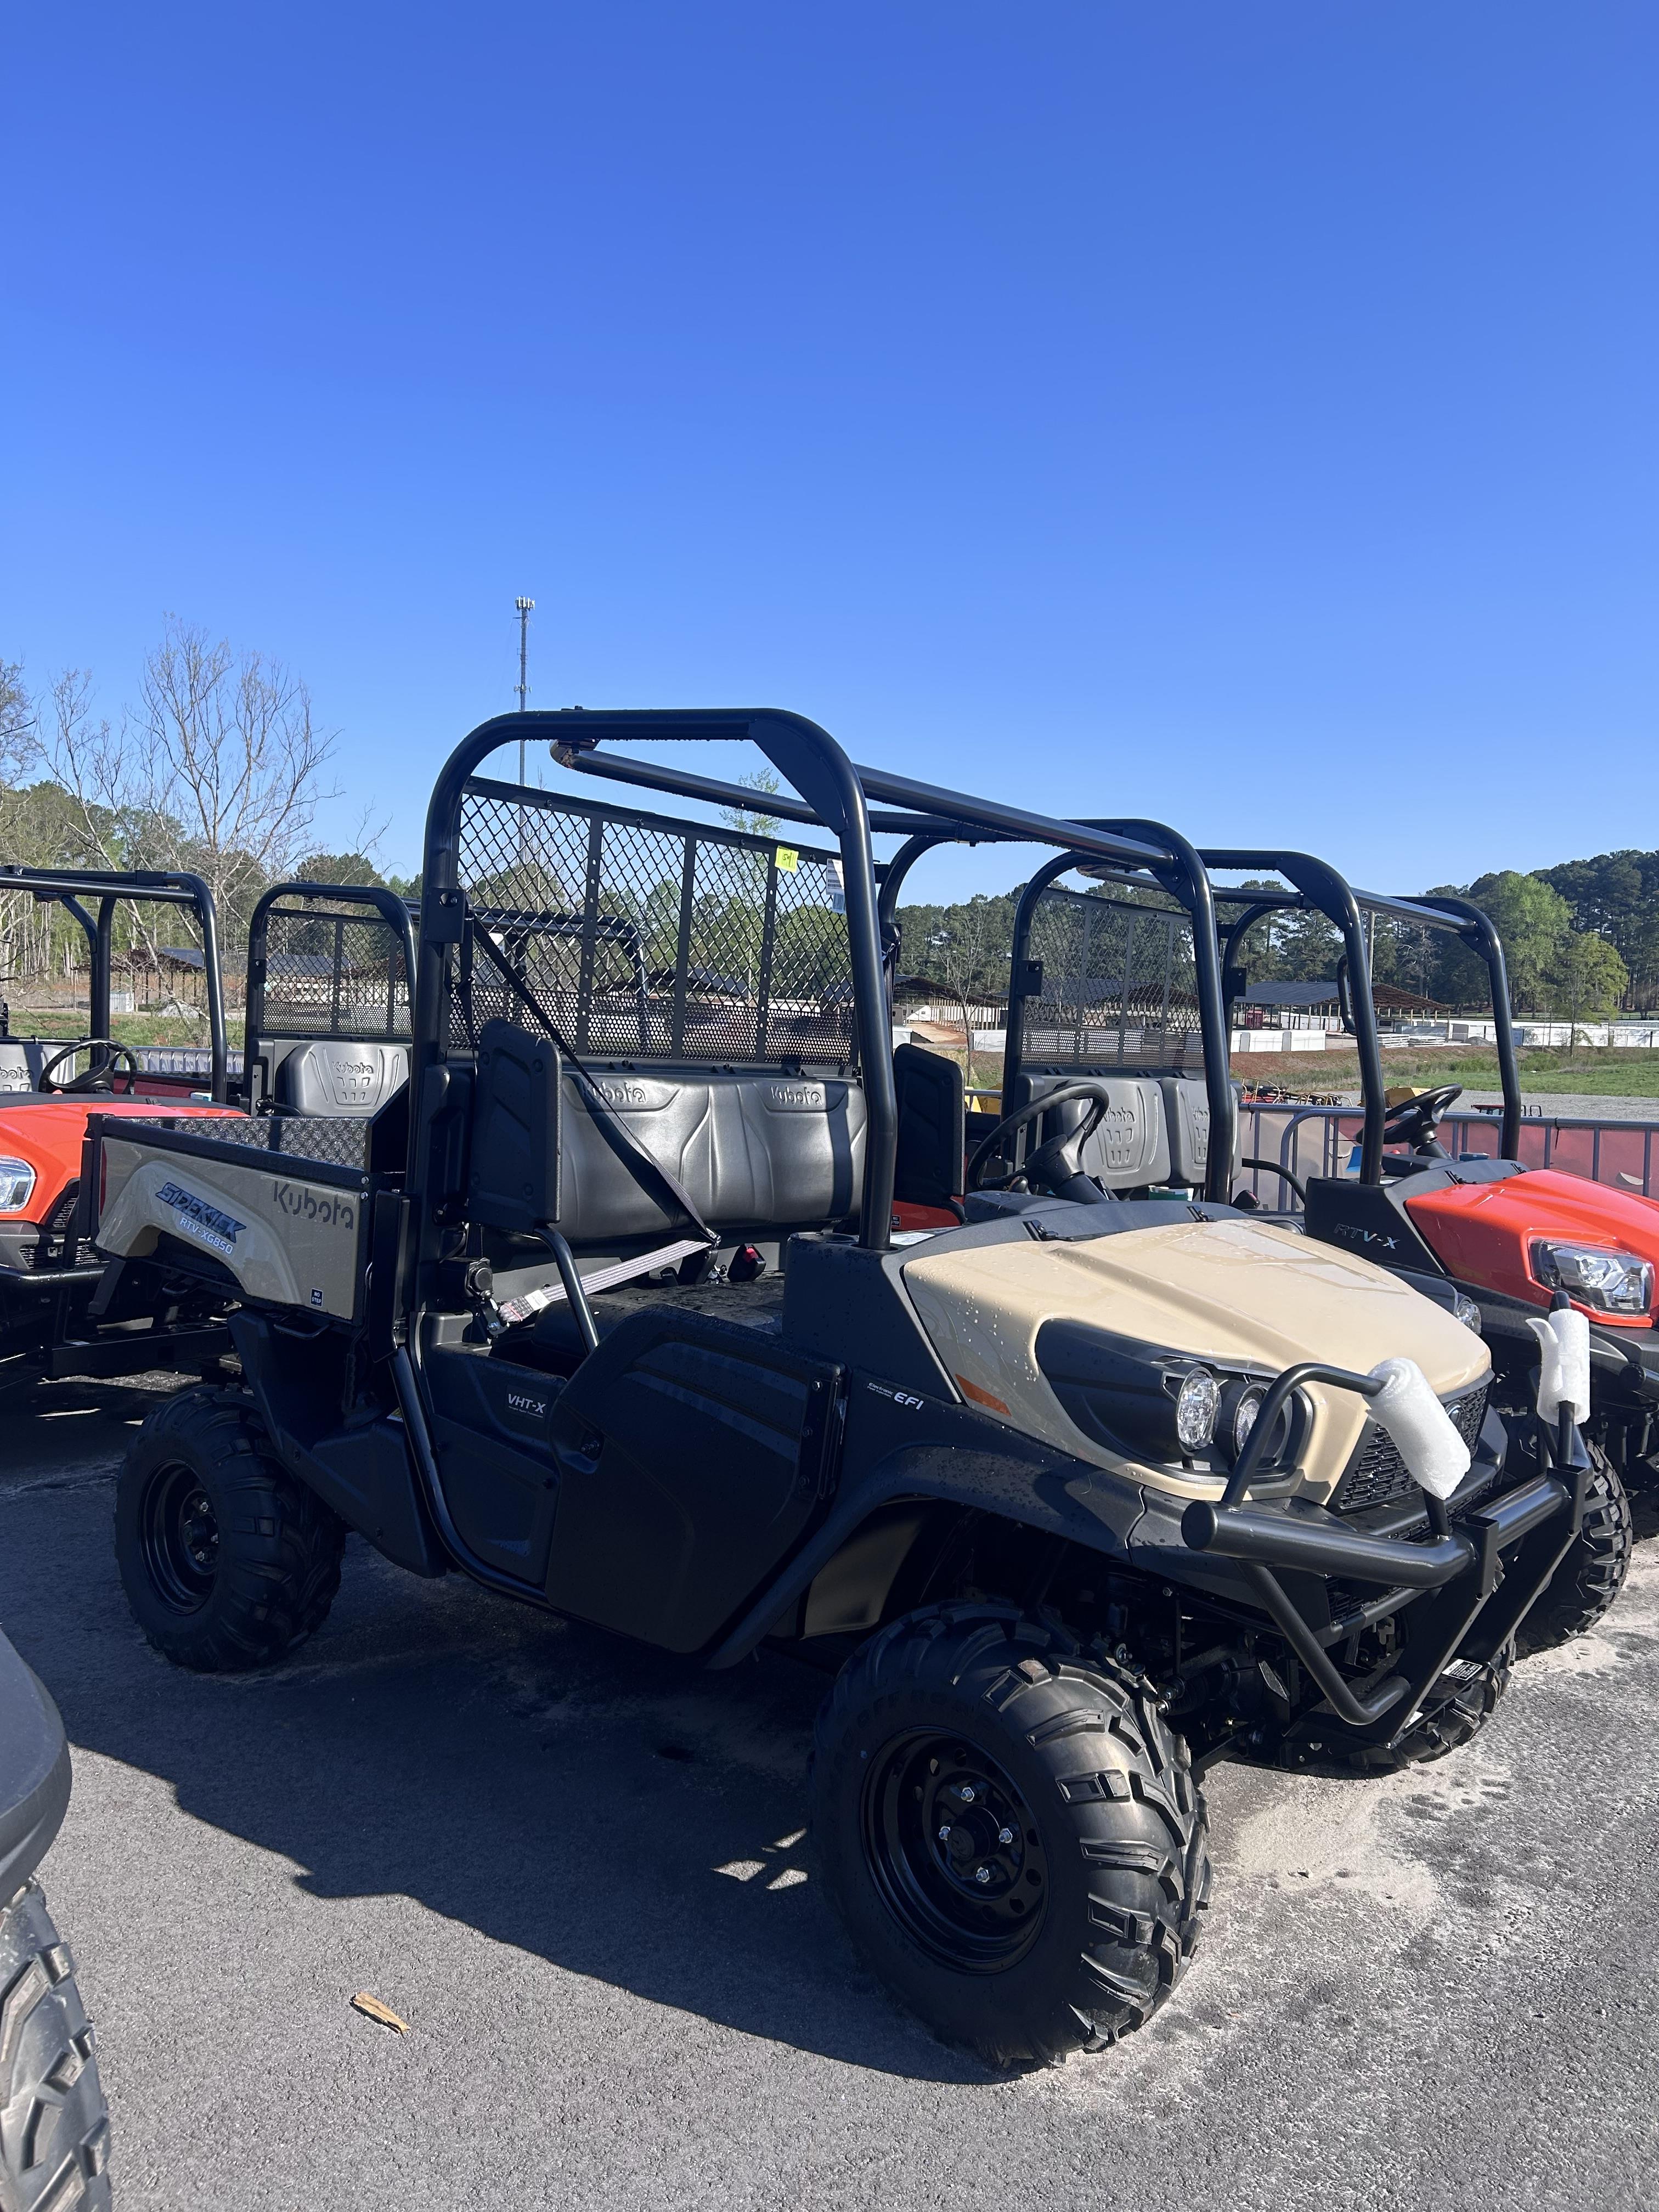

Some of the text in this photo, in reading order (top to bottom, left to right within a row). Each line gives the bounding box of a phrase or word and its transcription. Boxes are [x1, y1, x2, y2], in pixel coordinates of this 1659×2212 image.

[332, 1062, 374, 1074] Kubota
[770, 1086, 822, 1105] Kubota
[155, 1182, 246, 1243] SIDEKICK
[273, 1181, 354, 1229] Kubota
[179, 1217, 233, 1254] RTV-XG850
[1334, 1223, 1401, 1250] RTV-X
[508, 1393, 546, 1414] VHT-X
[894, 1392, 924, 1410] EFI
